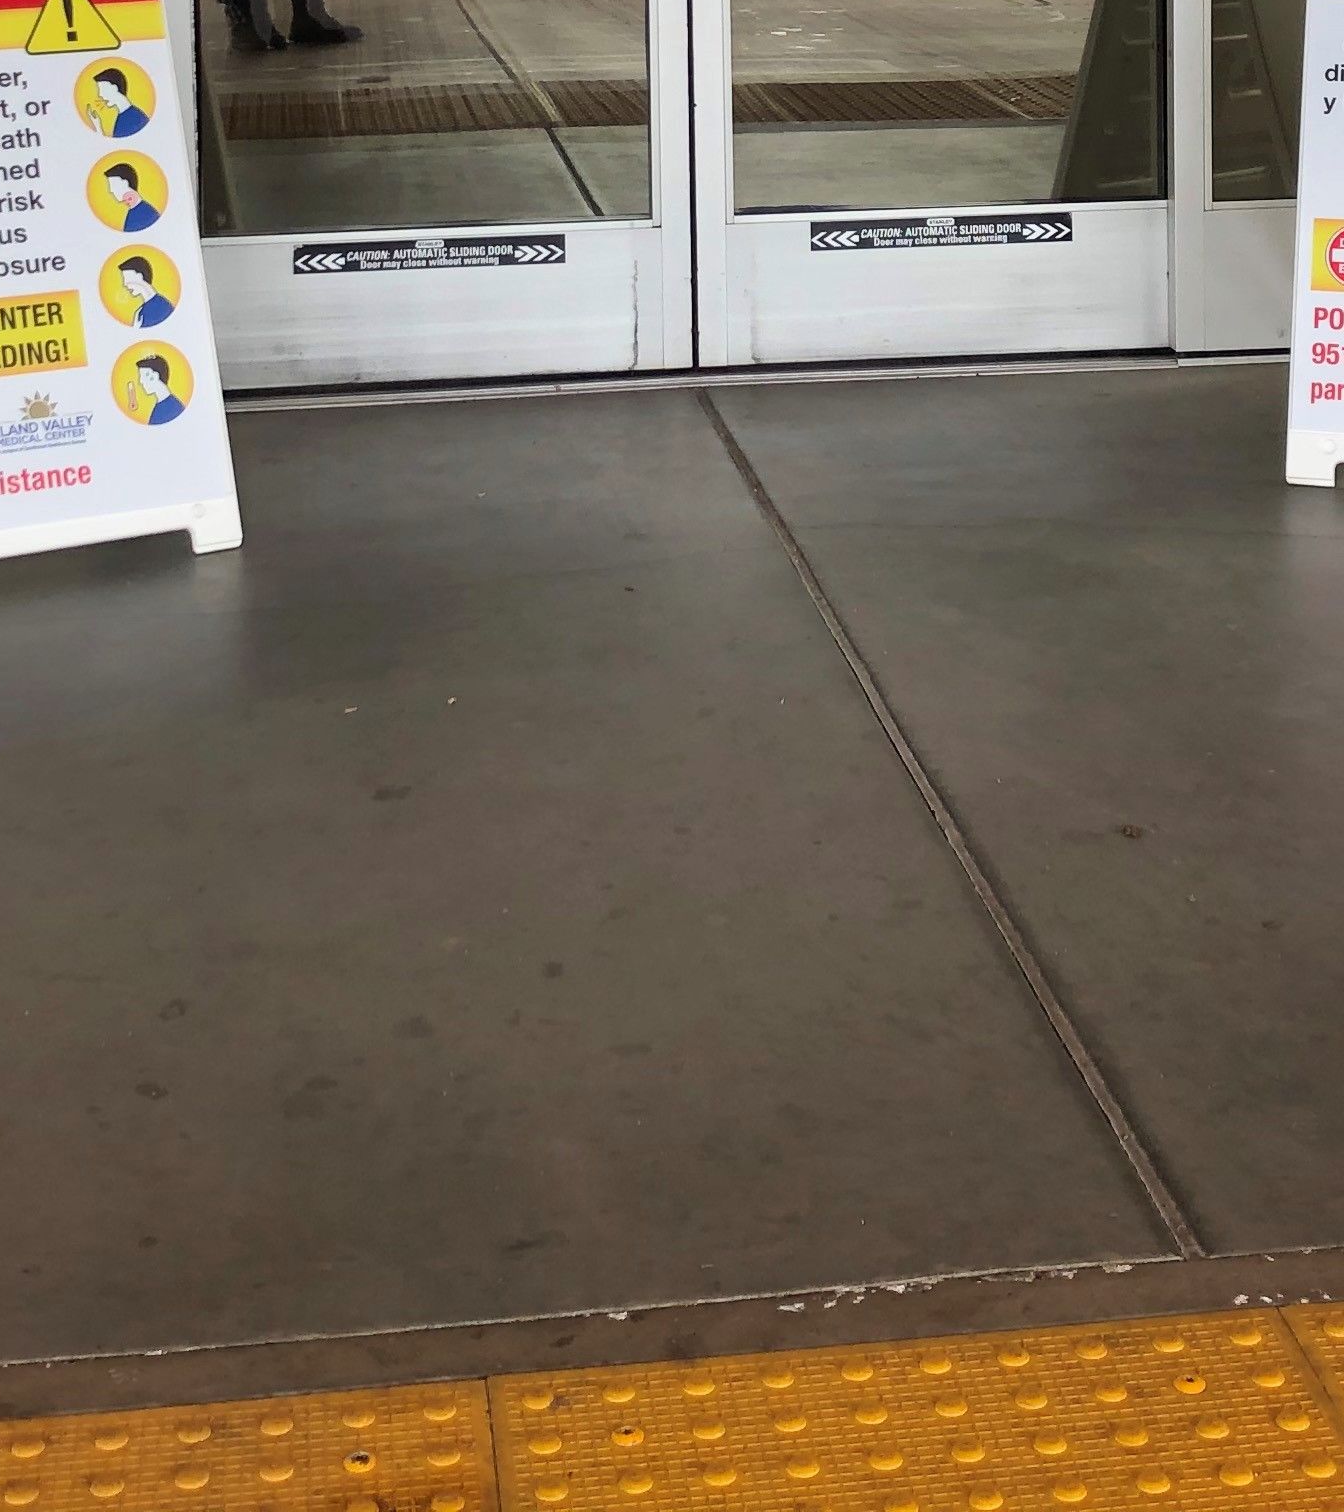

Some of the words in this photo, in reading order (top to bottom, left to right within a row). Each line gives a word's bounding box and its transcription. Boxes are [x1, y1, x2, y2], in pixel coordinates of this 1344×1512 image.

[25, 100, 50, 116] or
[861, 228, 903, 239] CAUTION:
[905, 226, 957, 237] AUTOMATIC
[960, 224, 994, 235] SLIDING
[997, 223, 1021, 233] DOOR
[346, 250, 390, 262] CAUTION:
[393, 248, 447, 259] AUTOMATIC
[450, 246, 485, 257] SLIDING
[488, 245, 513, 256] DOOR
